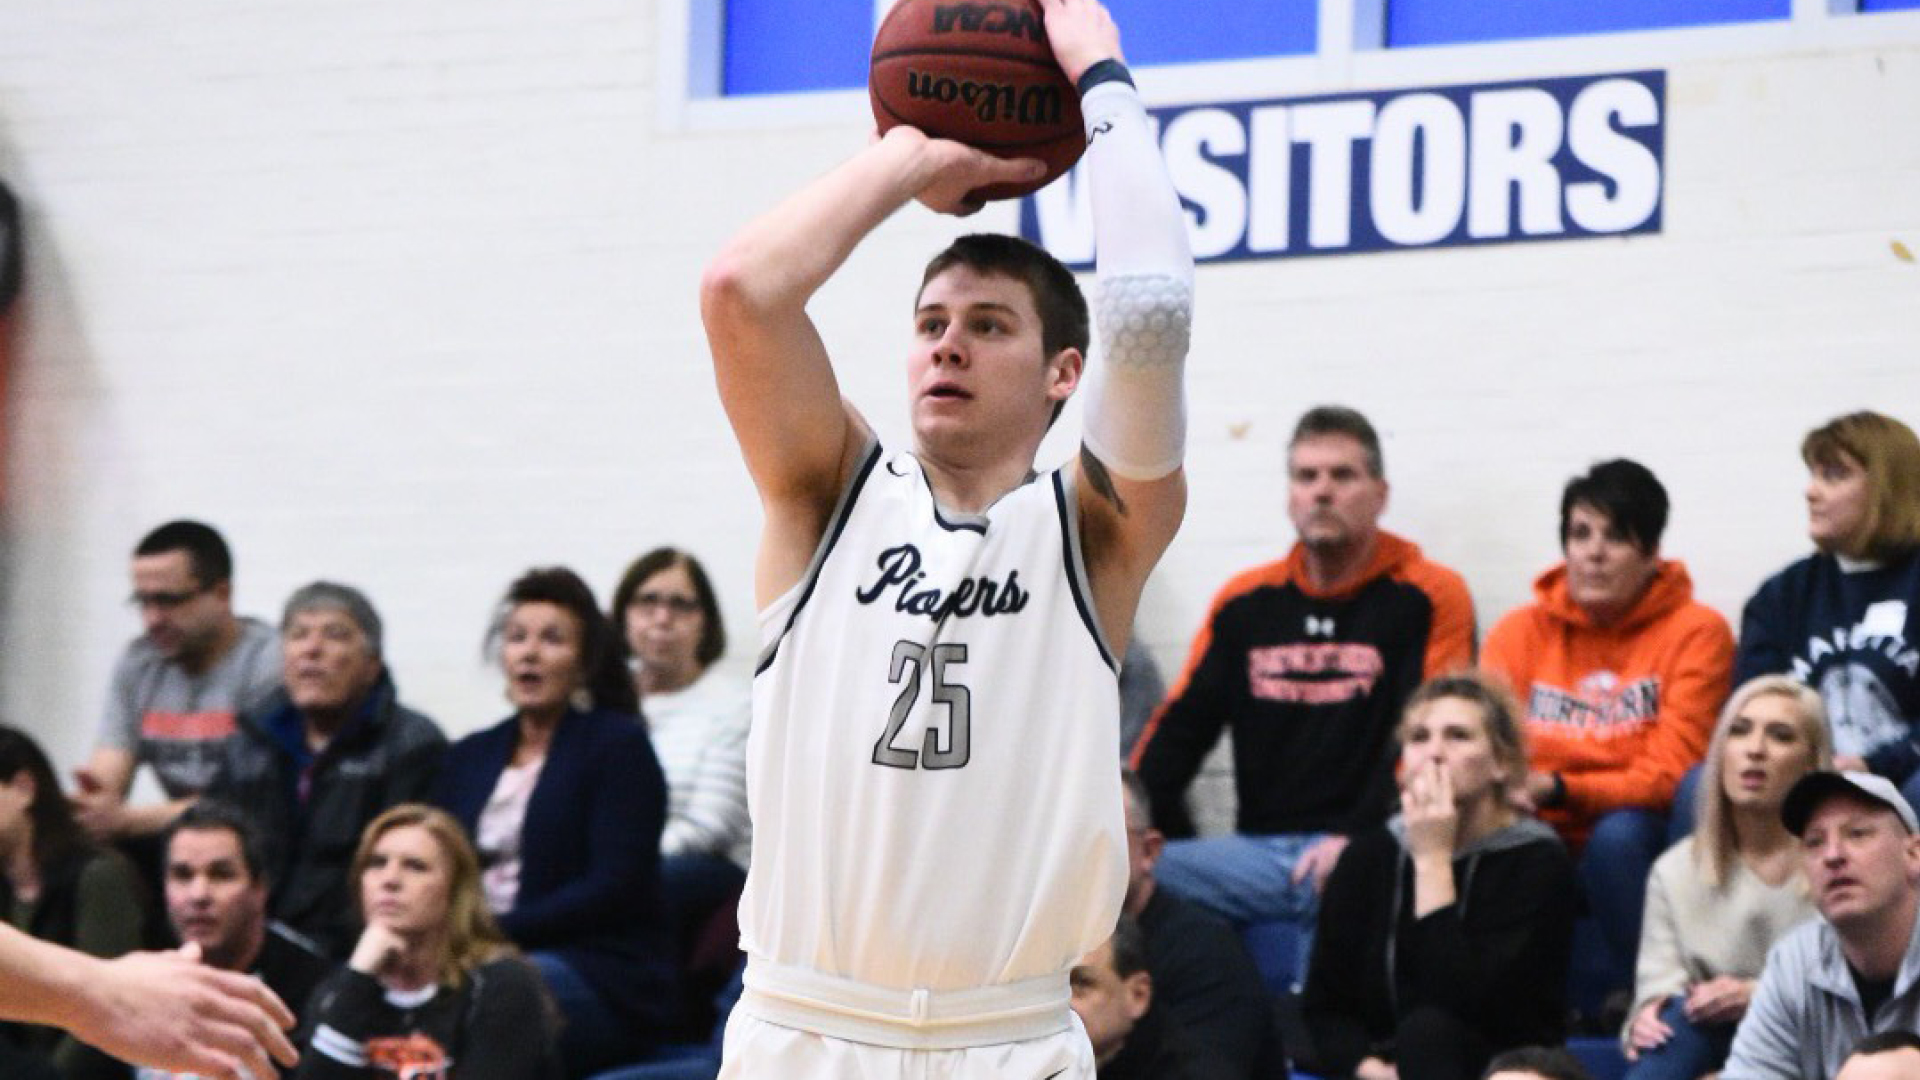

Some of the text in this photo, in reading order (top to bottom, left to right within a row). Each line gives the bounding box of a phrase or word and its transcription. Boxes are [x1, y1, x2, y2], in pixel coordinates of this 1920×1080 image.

[908, 71, 1060, 125] Wilson
[1033, 78, 1660, 264] VSITORS
[856, 543, 1029, 621] Pioers
[872, 639, 970, 770] 25
